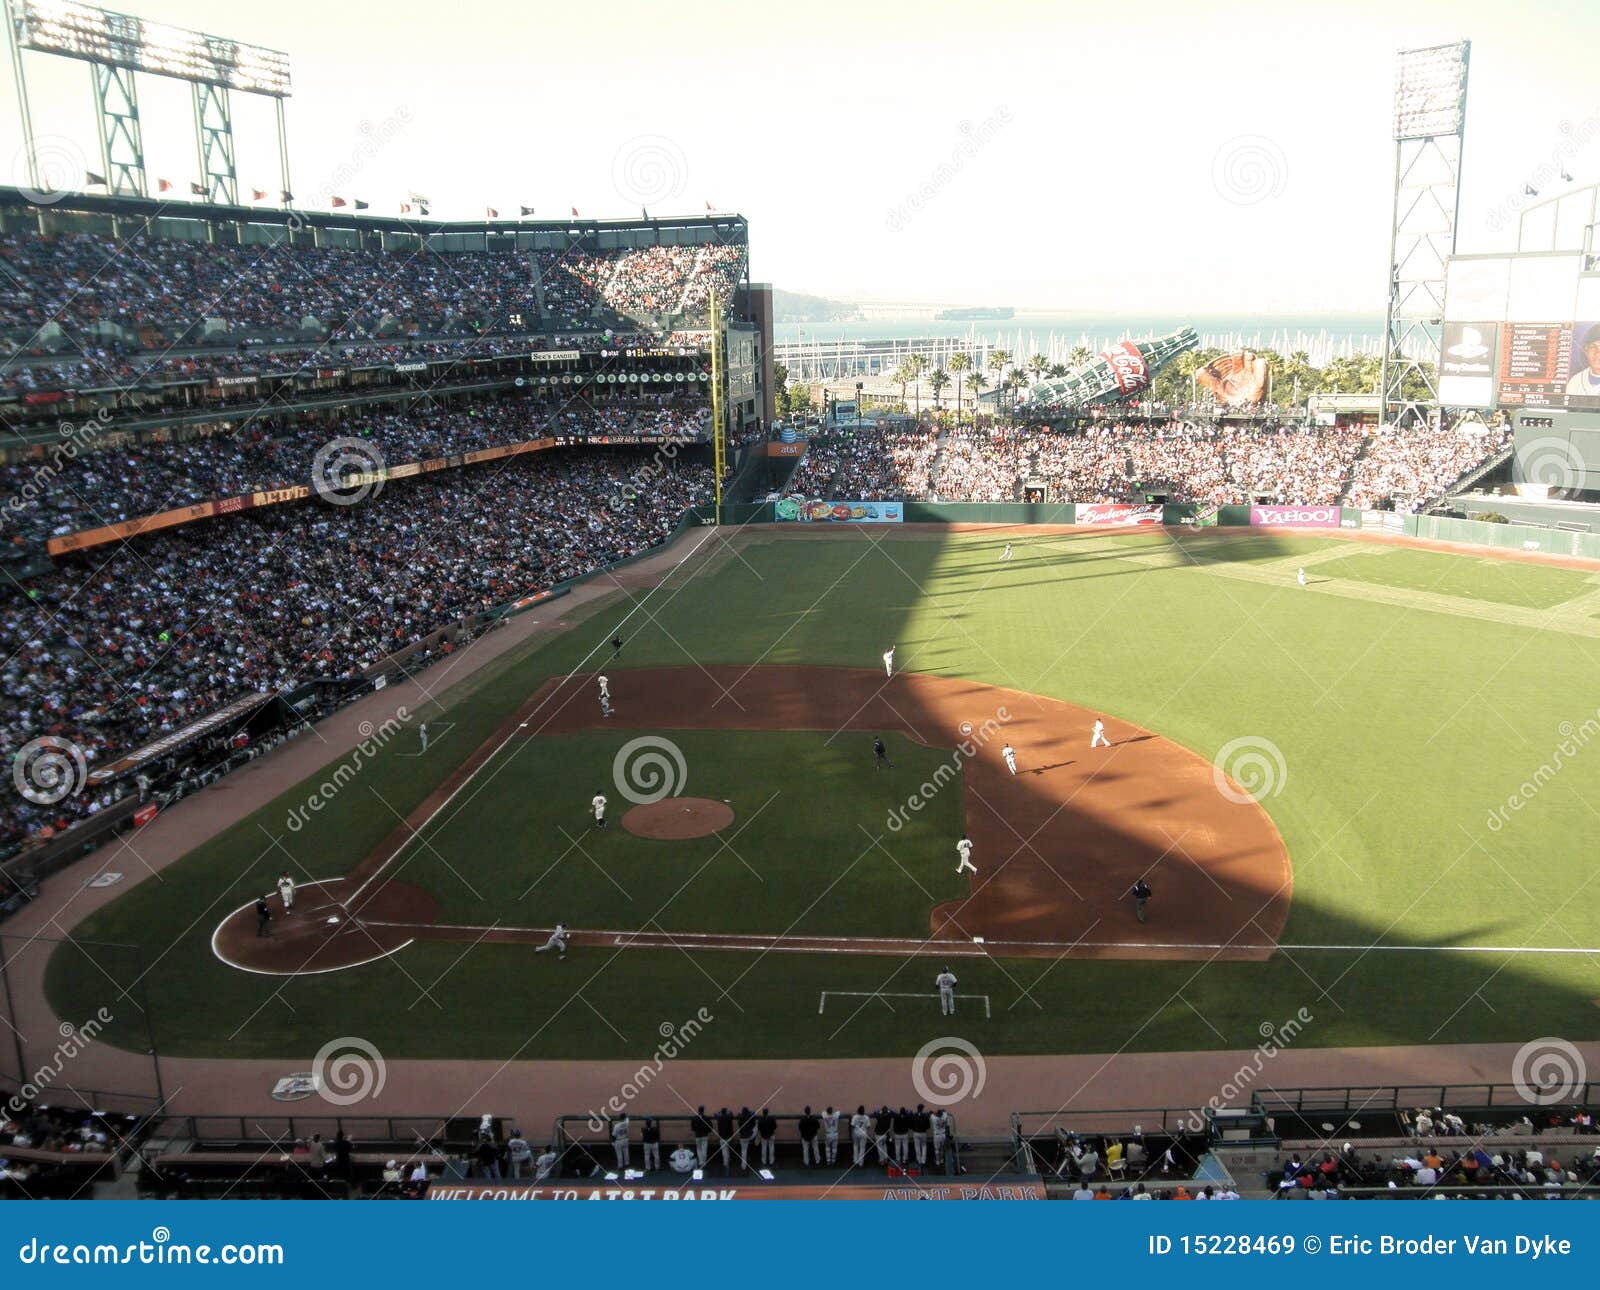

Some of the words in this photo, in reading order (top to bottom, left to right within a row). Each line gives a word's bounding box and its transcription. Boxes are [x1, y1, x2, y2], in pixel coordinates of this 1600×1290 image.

[780, 445, 798, 454] at&t
[1083, 503, 1153, 524] Budweiser
[1254, 508, 1336, 525] YAHOO!
